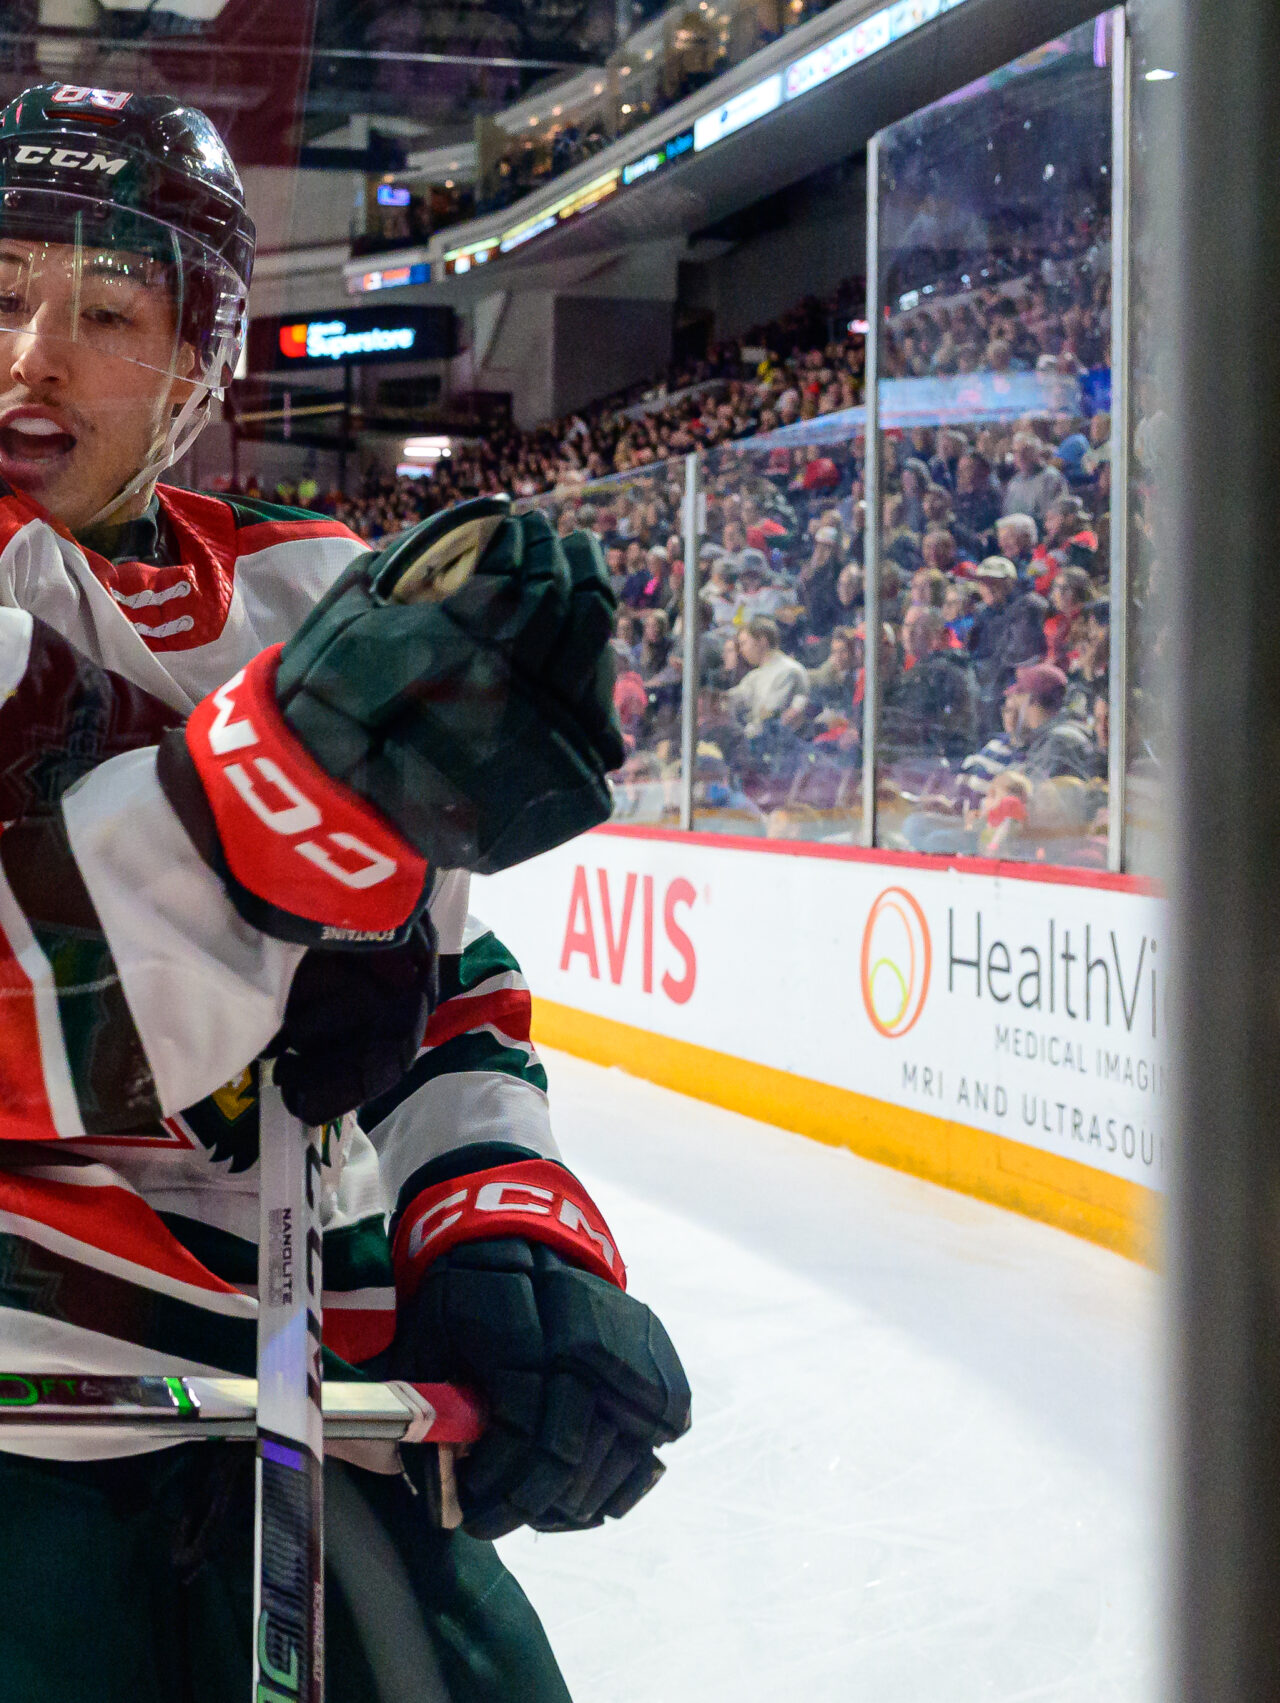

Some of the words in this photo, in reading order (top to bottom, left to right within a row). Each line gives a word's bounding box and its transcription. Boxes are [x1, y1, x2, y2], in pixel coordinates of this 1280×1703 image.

[14, 145, 129, 175] CCM
[207, 668, 397, 889] CCM
[560, 865, 697, 1004] AVIS
[903, 1061, 943, 1099] MRI
[957, 1077, 1007, 1117] AND
[995, 1023, 1087, 1074] MEDICAL
[282, 1207, 292, 1307] NANOLITE
[409, 1182, 614, 1269] CCM
